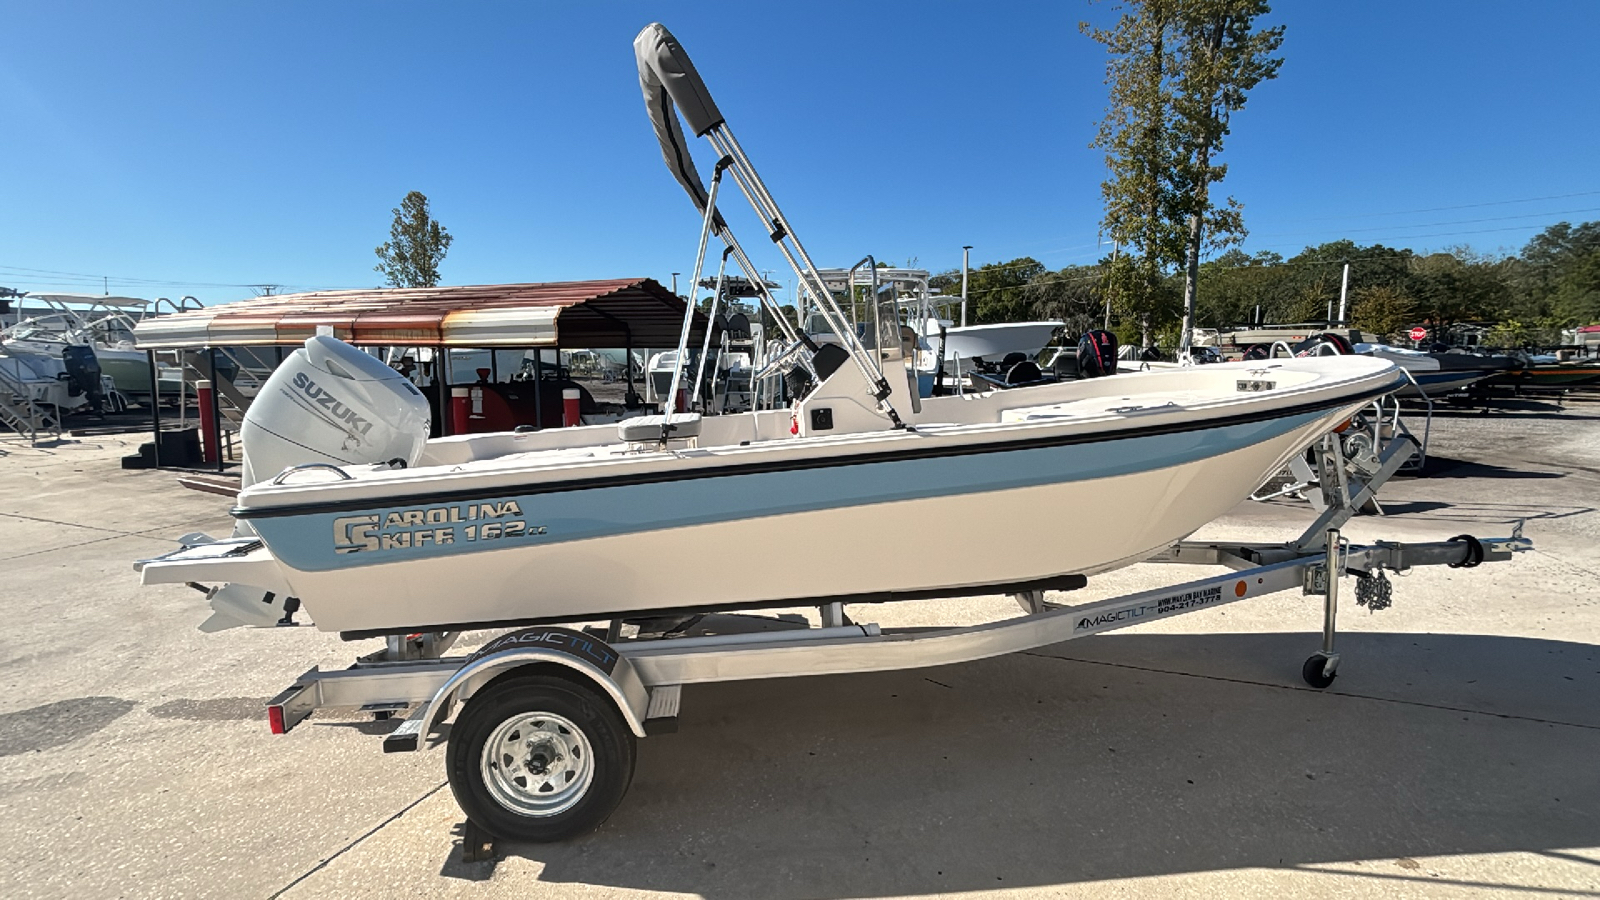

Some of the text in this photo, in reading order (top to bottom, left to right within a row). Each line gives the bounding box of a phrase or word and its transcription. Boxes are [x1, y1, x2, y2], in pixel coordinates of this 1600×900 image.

[292, 372, 374, 436] SUZUKI
[333, 500, 523, 546] CAROLINA
[1086, 606, 1147, 628] MAGICTILT
[465, 632, 615, 664] MAGICTILT
